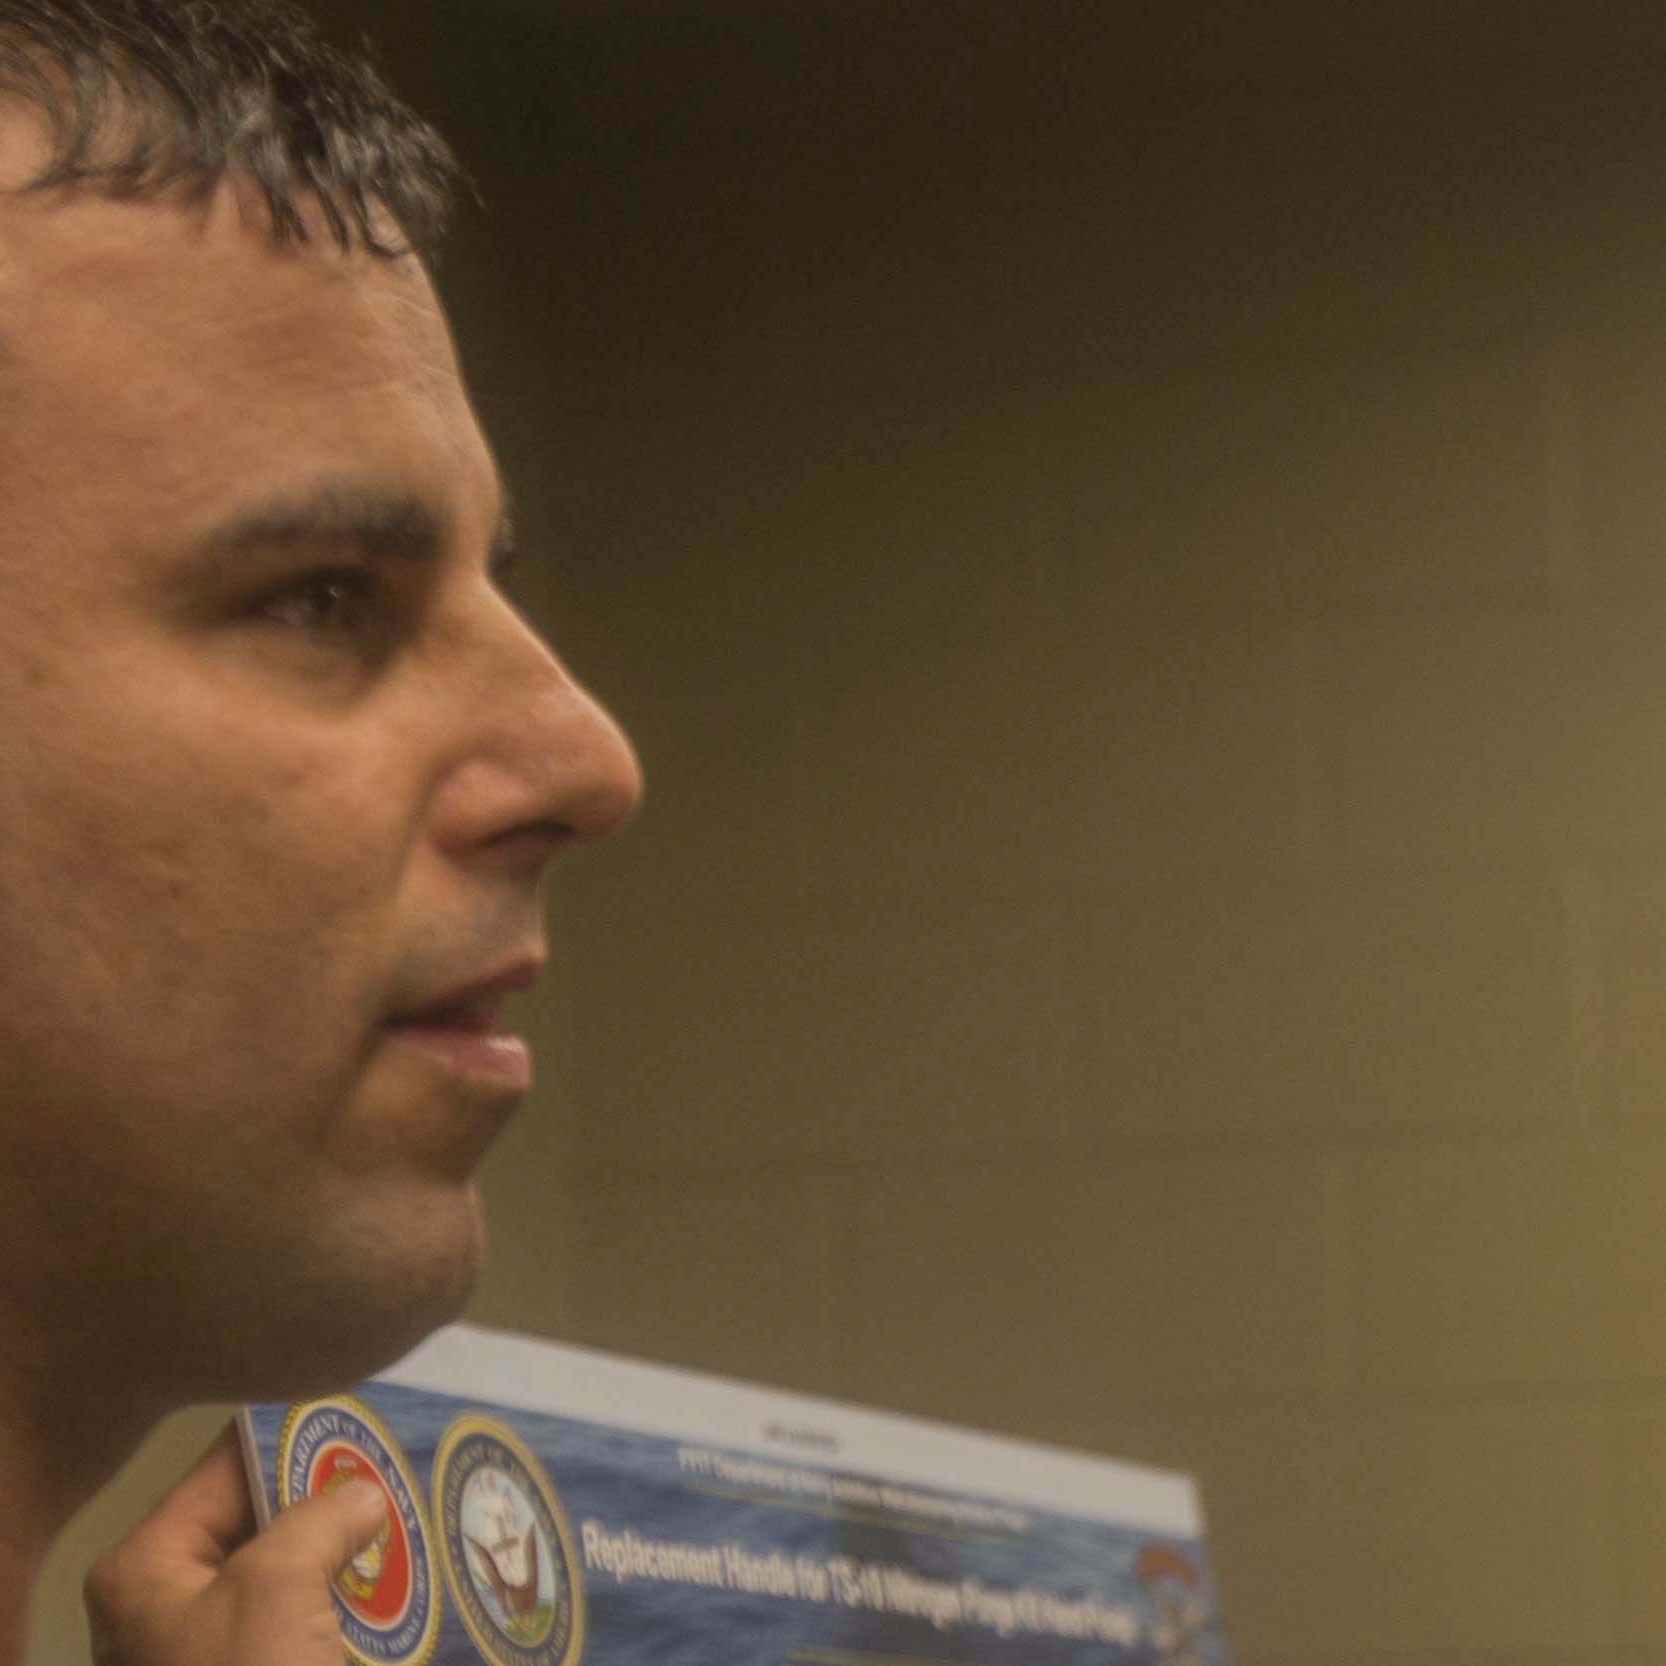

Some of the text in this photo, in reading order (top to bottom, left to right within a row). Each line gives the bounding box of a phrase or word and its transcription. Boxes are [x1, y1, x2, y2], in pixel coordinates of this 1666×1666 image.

[581, 1521, 723, 1586] Replacement
[723, 1543, 796, 1598] Handle
[796, 1556, 827, 1601] for
